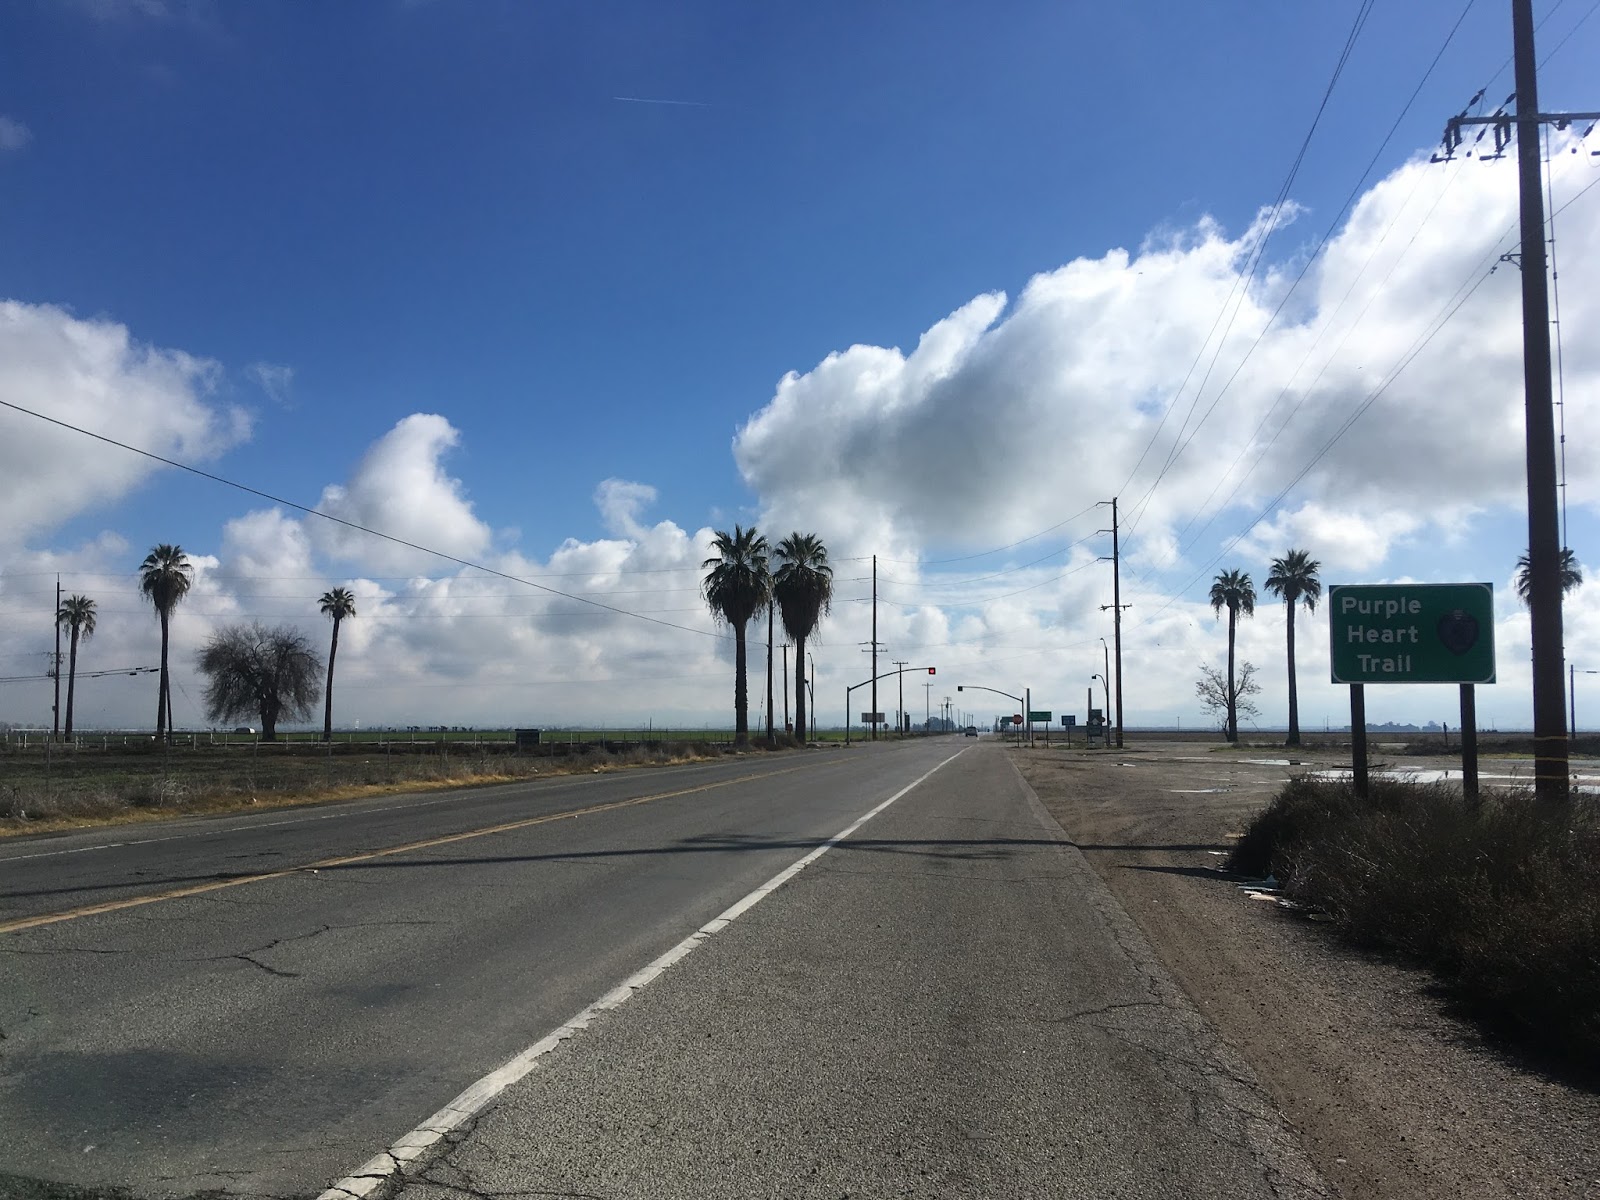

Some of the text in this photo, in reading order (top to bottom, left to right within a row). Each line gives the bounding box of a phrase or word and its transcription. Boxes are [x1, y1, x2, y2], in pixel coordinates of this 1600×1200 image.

[1342, 597, 1421, 618] Purple
[1348, 625, 1418, 643] Heart
[1357, 654, 1411, 672] Trail
